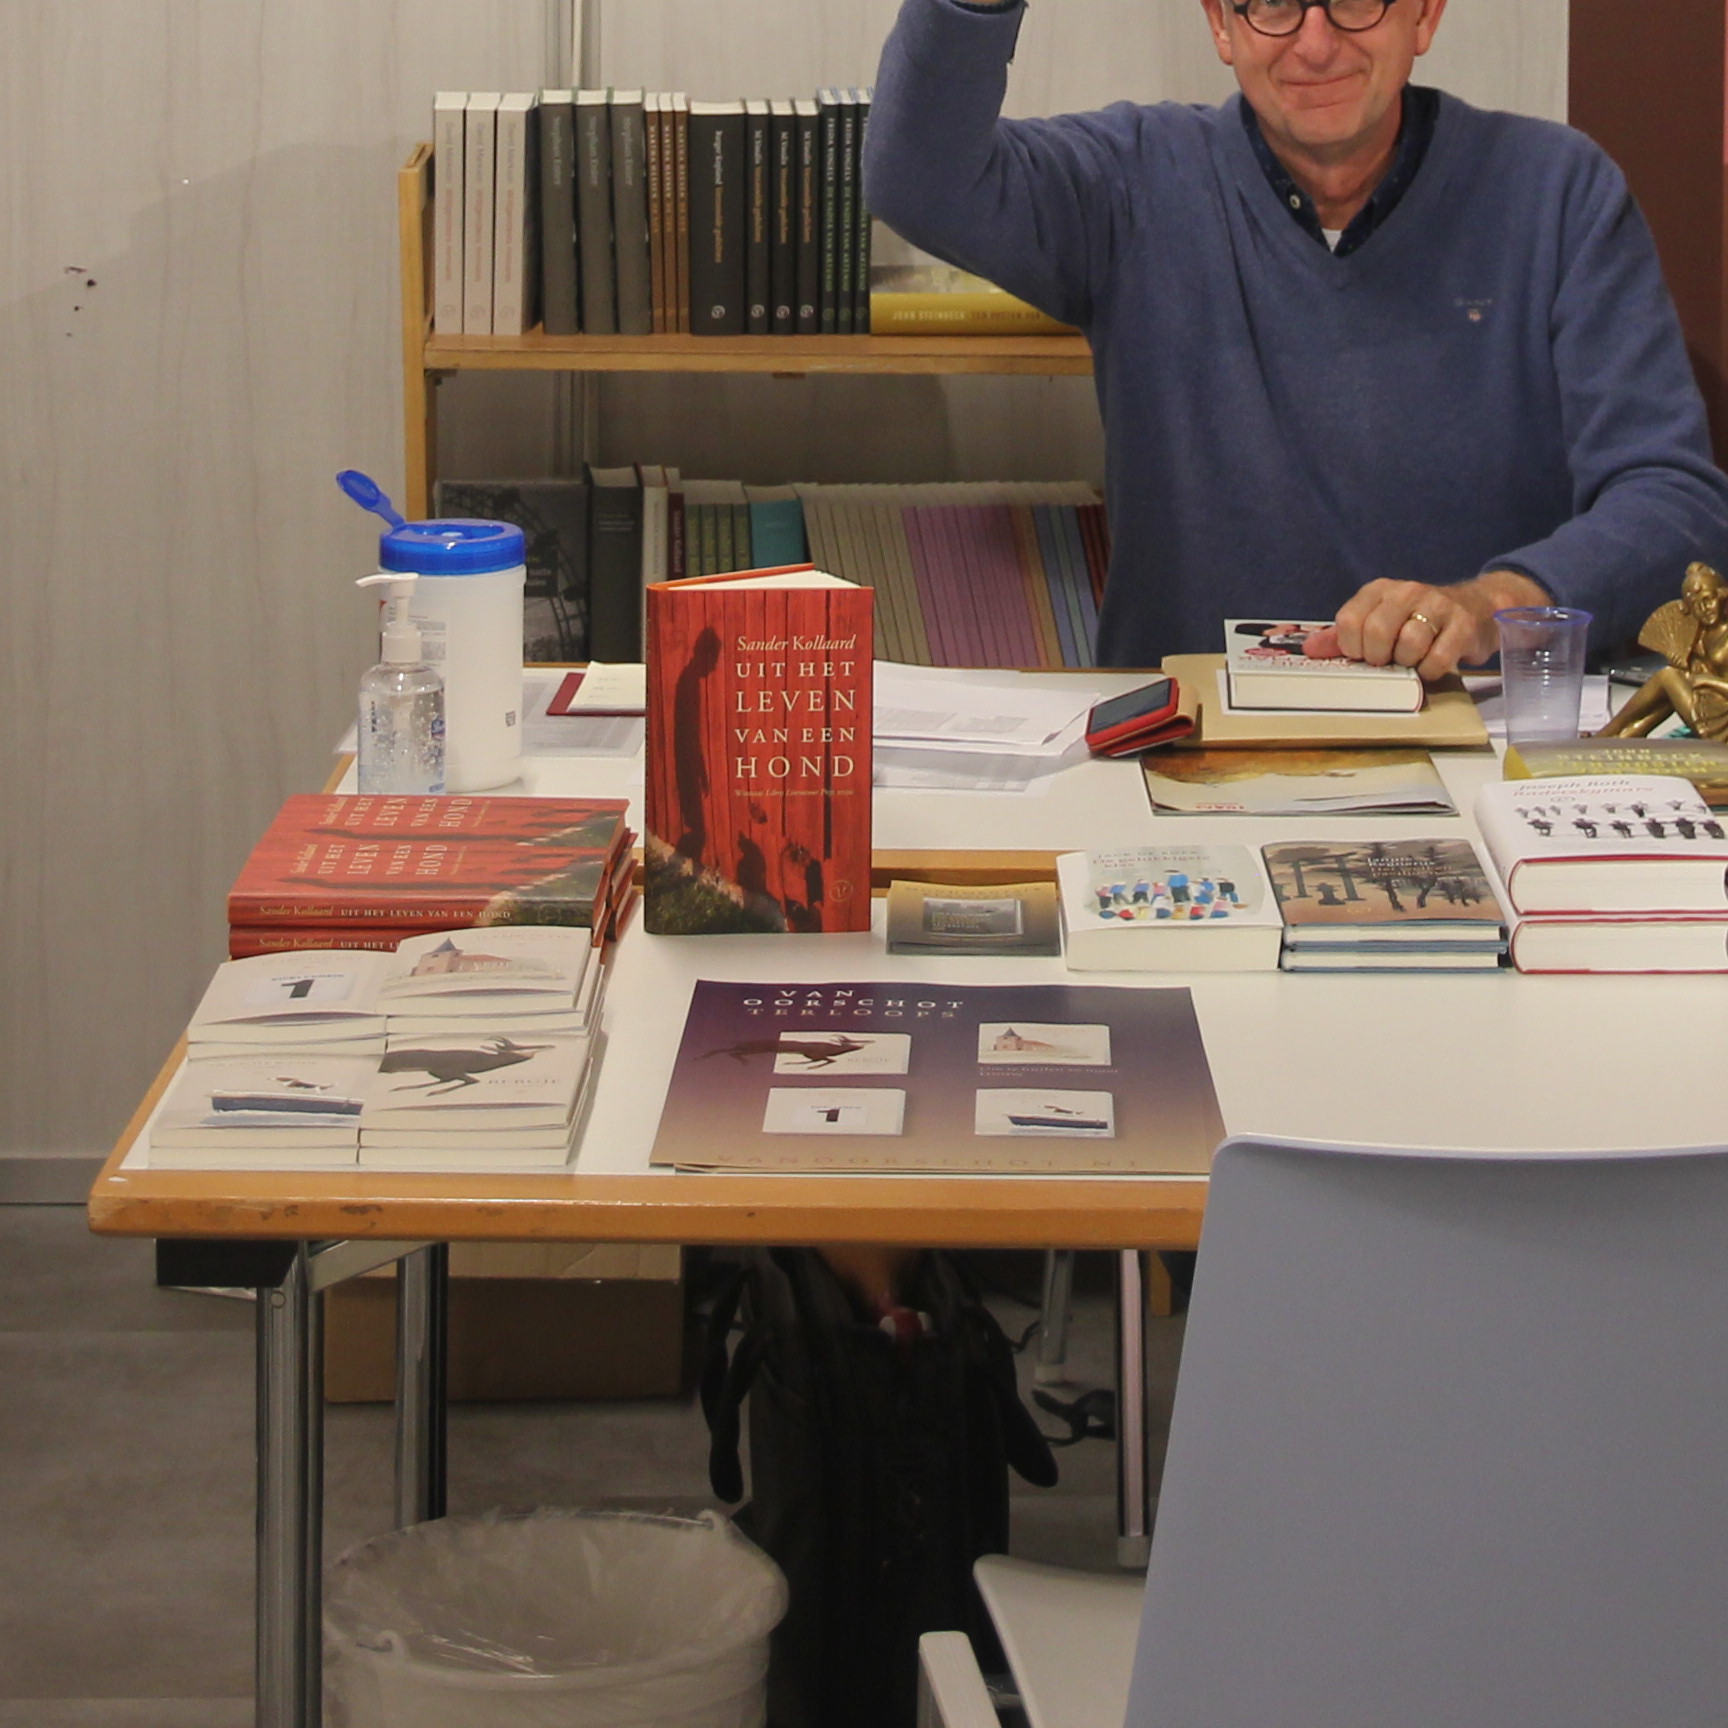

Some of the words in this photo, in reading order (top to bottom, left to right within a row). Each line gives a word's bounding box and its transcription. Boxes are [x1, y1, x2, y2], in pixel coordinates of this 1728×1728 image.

[737, 635, 788, 651] Sander
[793, 634, 856, 650] Kollaard
[736, 662, 785, 677] UIT
[799, 661, 854, 676] HET
[736, 690, 855, 712] LEVEN
[735, 728, 789, 743] VAN
[801, 727, 855, 742] EEN
[736, 756, 854, 778] HOND
[259, 904, 291, 917] Sander
[294, 905, 334, 917] Kollaard
[341, 908, 358, 917] UIT
[364, 908, 385, 917] HET
[390, 908, 424, 918] LEVEN
[428, 908, 449, 918] VAN
[453, 909, 474, 918] EEN
[478, 910, 511, 919] HOND
[258, 937, 291, 949] Sander
[340, 940, 358, 949] UIT
[363, 940, 385, 949] HET
[282, 979, 314, 998] 1
[780, 990, 855, 998] VAN
[743, 998, 963, 1009] OORSCHOT
[747, 1009, 956, 1018] TERLOOPS
